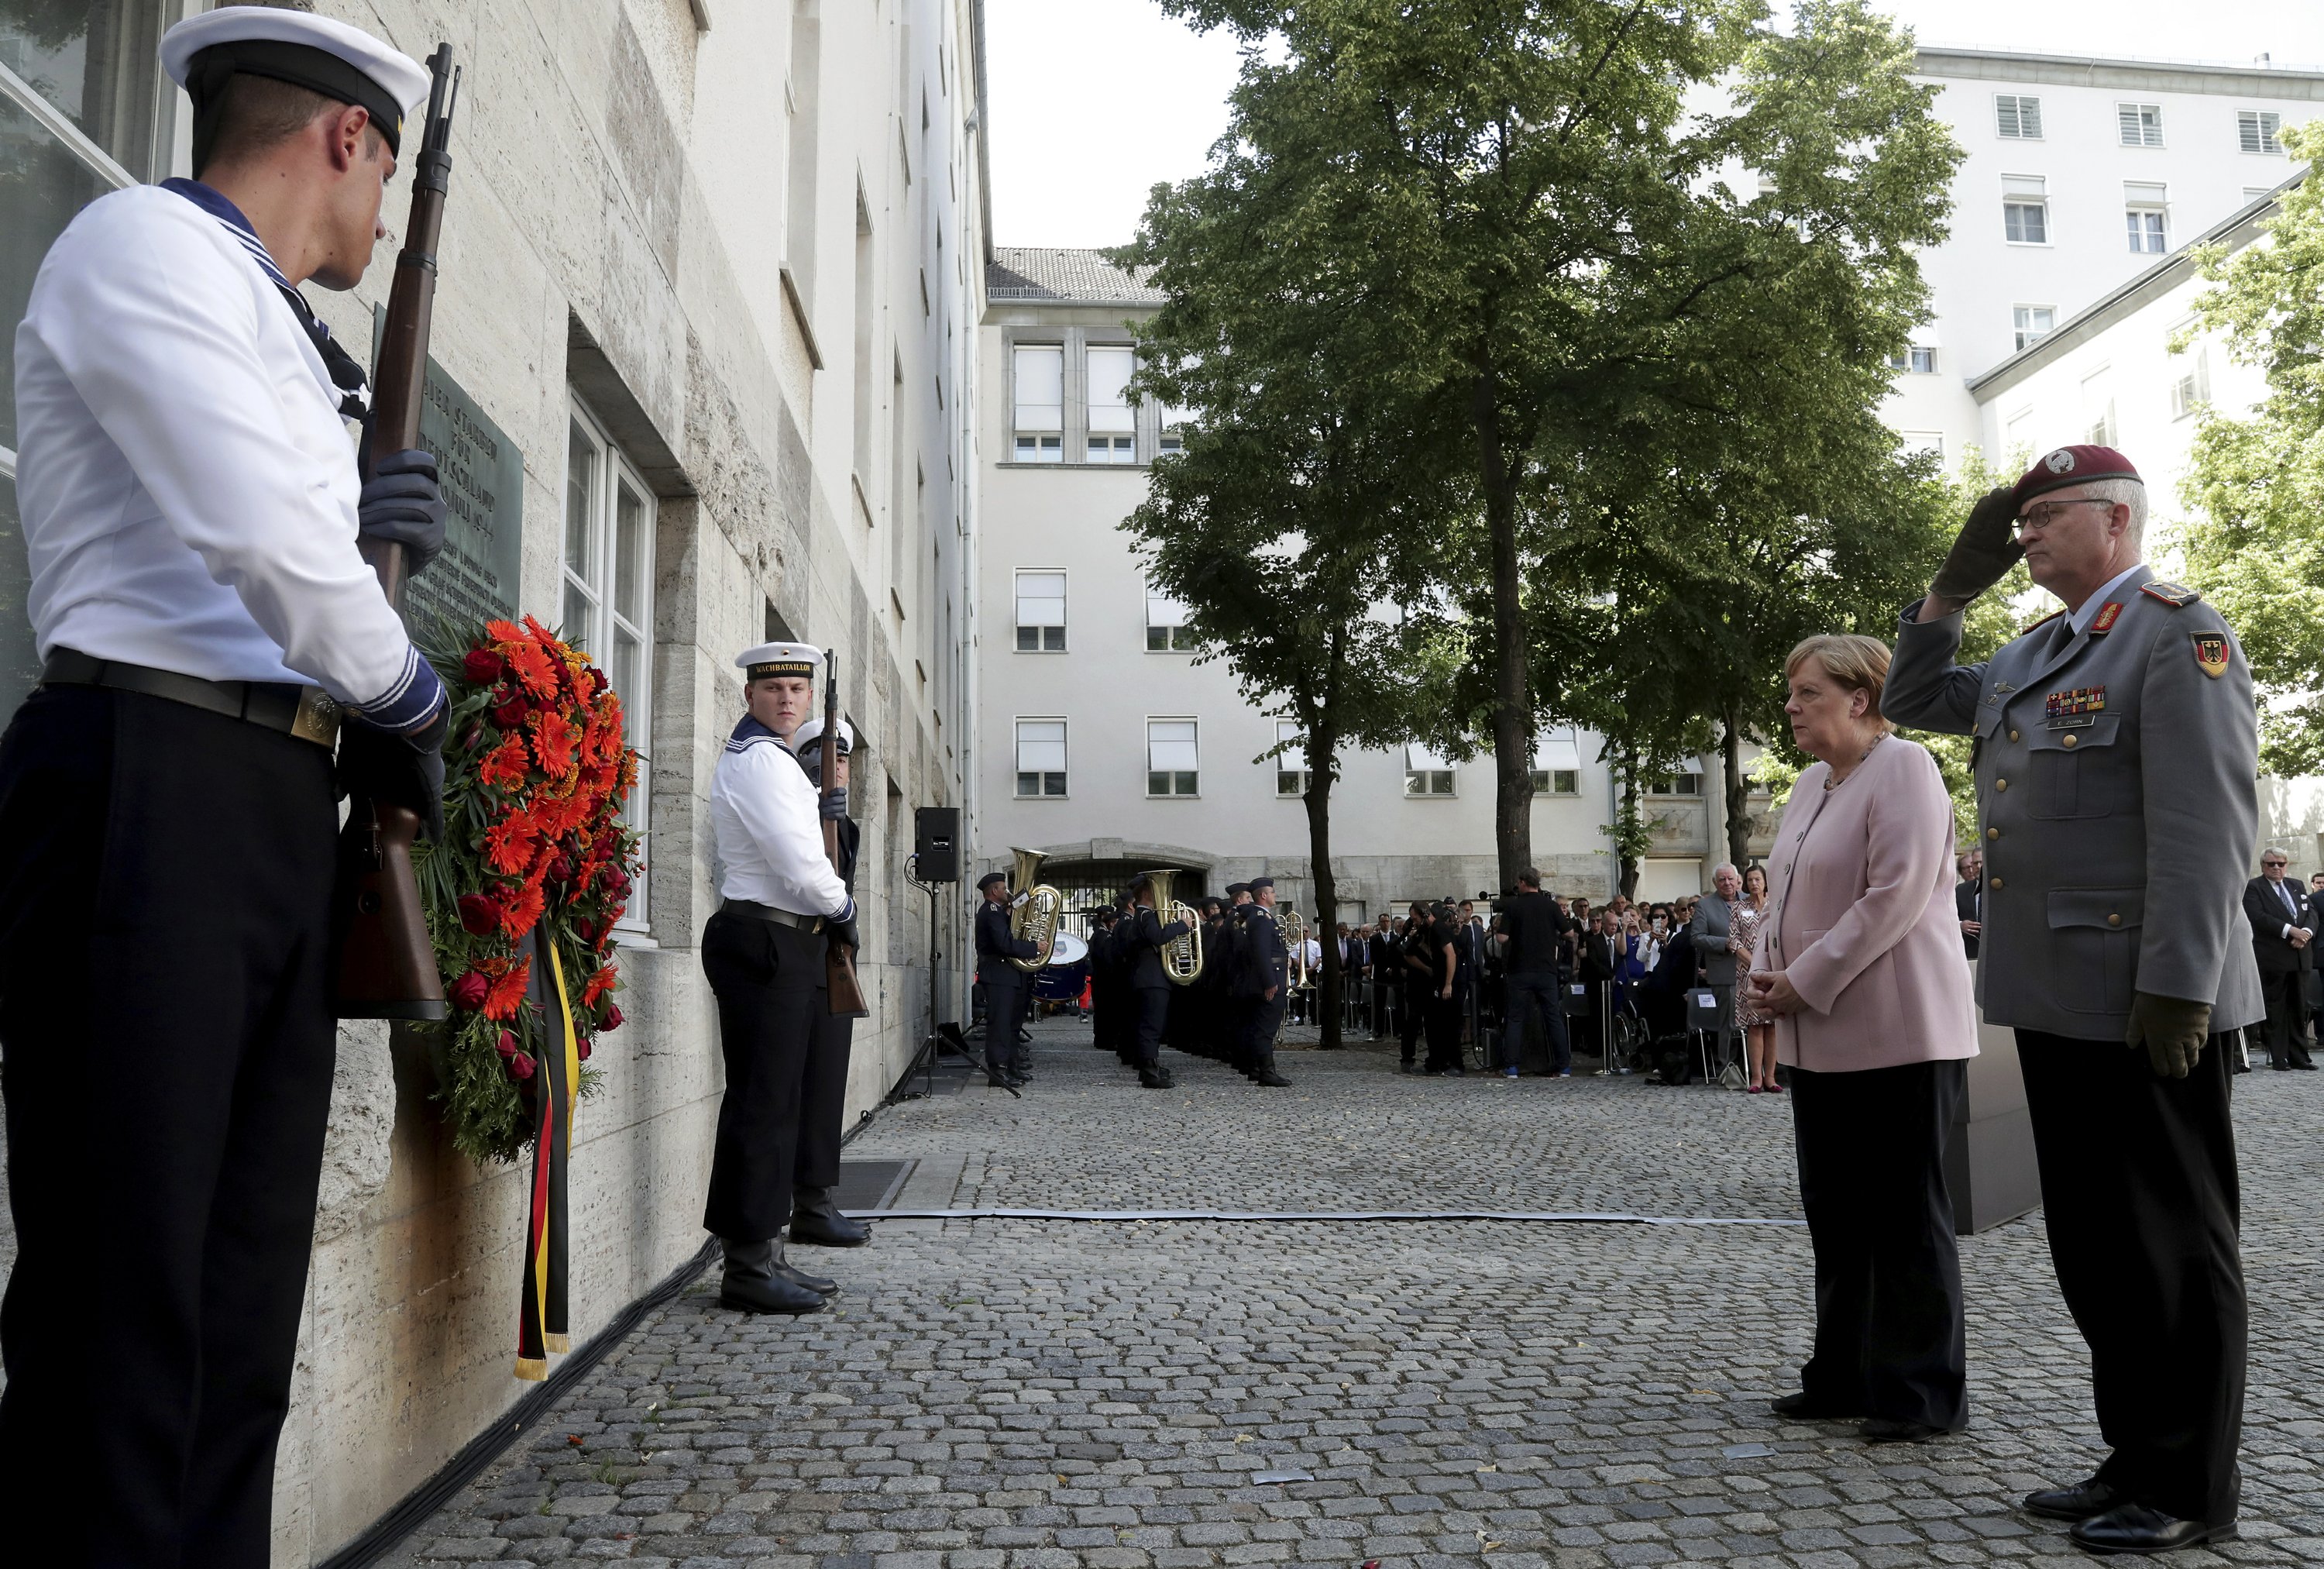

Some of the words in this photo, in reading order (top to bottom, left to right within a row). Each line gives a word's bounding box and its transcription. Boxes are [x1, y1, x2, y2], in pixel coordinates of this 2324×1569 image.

[451, 430, 470, 465] FÜR
[418, 432, 495, 512] DEUTSCHLAND
[756, 663, 810, 673] WACHBATAILLON
